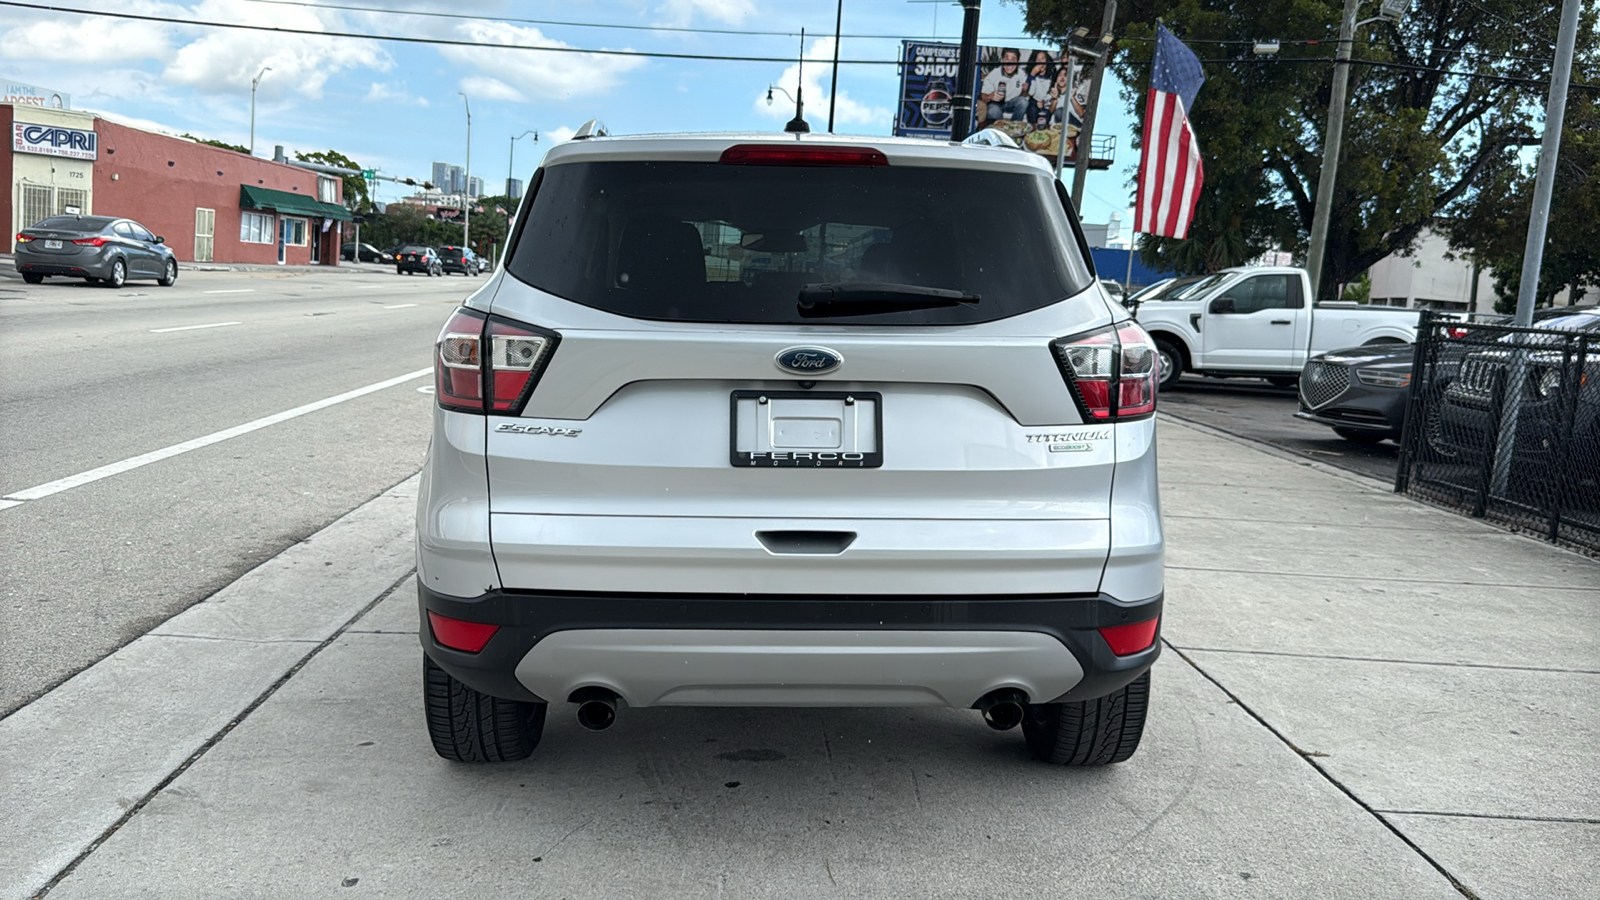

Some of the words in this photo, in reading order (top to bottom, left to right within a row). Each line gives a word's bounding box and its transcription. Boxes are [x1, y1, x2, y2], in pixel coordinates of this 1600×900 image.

[916, 46, 956, 58] CAMPEONES
[915, 56, 960, 78] SABO
[10, 85, 21, 95] AM
[22, 86, 36, 96] THE
[3, 95, 45, 106] ARGEST
[15, 124, 23, 145] BAR
[23, 126, 95, 152] CAPRI
[69, 171, 84, 179] 1725
[791, 352, 825, 368] Ford
[494, 423, 583, 437] ESCAPE
[1026, 430, 1112, 443] TITANIUM
[750, 452, 864, 461] FERCO
